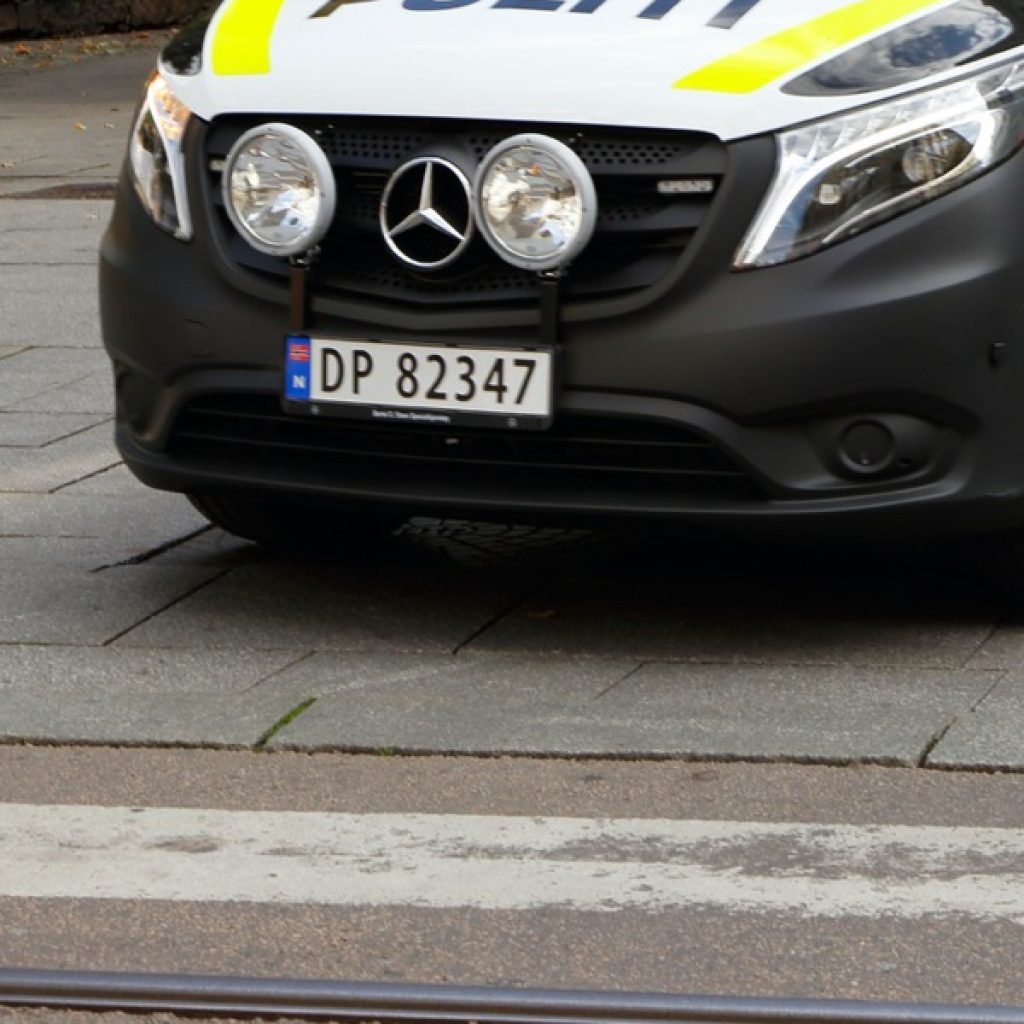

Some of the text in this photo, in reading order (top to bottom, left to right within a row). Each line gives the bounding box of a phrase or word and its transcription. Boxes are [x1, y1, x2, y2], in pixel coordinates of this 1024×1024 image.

[293, 375, 305, 388] N
[320, 347, 537, 405] DP 82347
